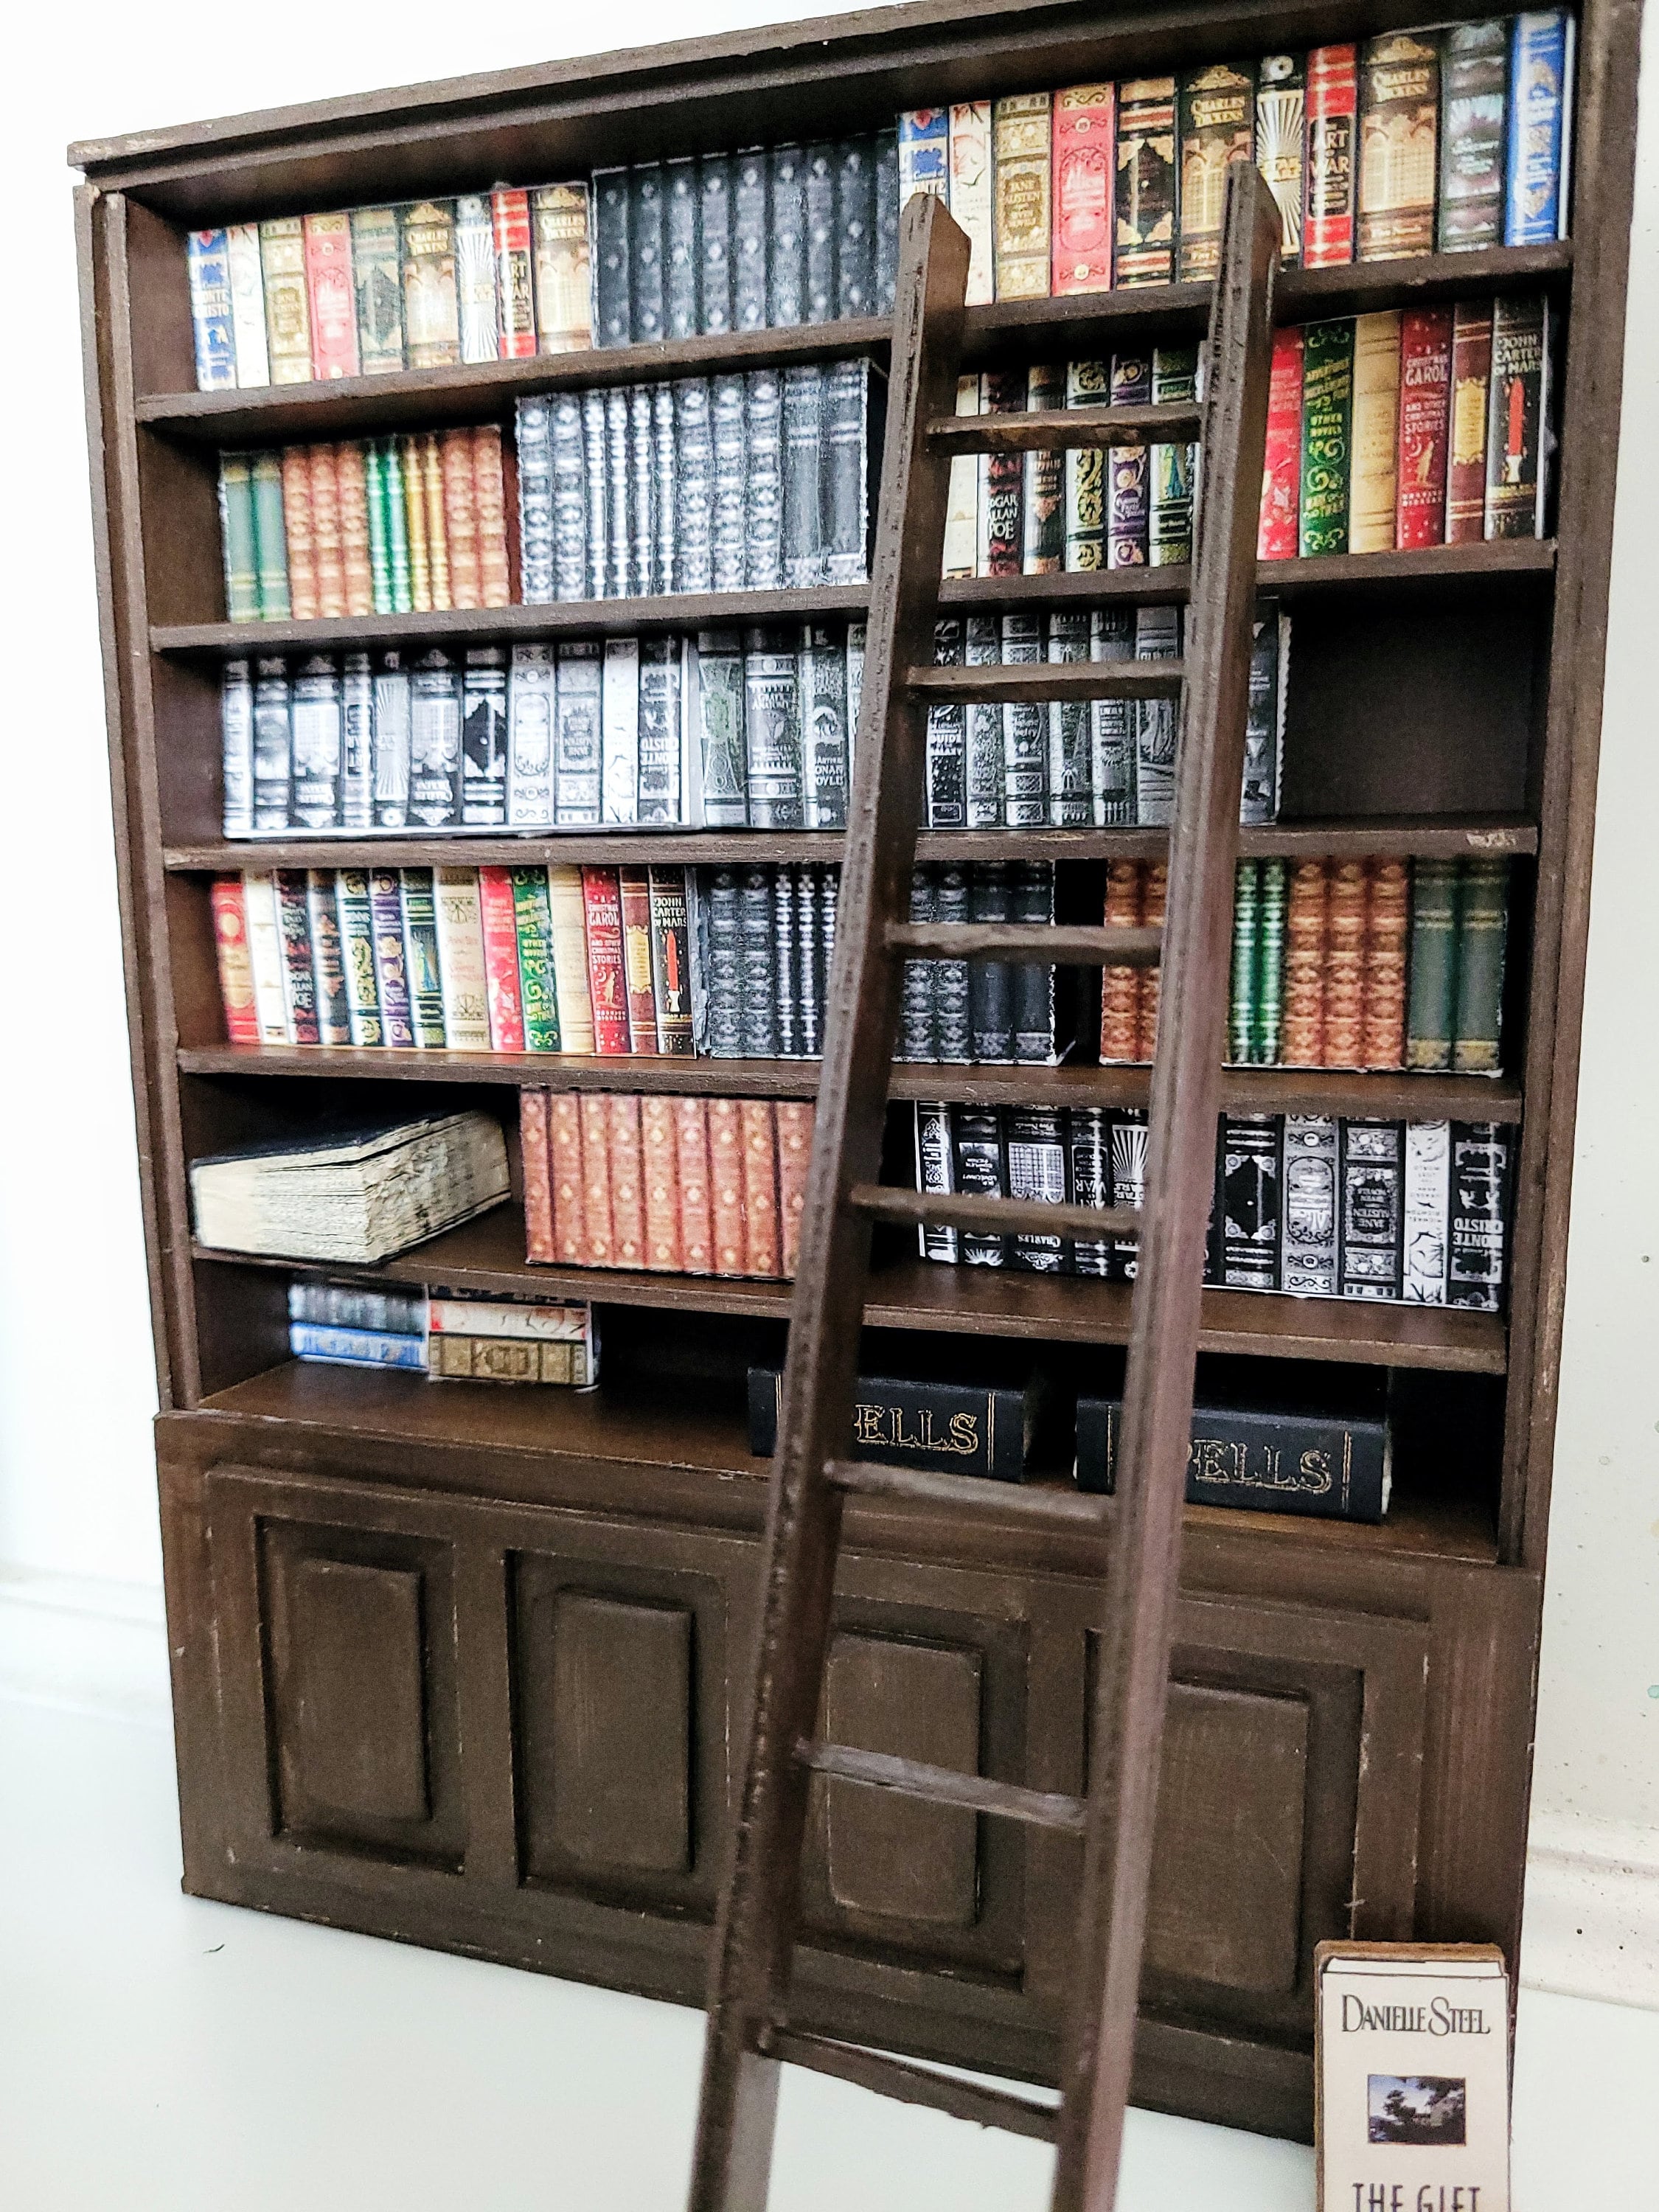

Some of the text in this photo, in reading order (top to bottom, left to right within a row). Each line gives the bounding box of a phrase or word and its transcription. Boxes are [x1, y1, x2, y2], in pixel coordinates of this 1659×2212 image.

[1405, 364, 1448, 386] CAROL
[988, 521, 1015, 540] POE
[653, 897, 682, 907] JOHN
[589, 911, 620, 926] CAROL
[653, 907, 686, 917] CARTER
[664, 917, 687, 927] MARS
[592, 954, 622, 964] STORIES
[1075, 1178, 1107, 1193] WAR
[1353, 1208, 1389, 1218] AUSTEN
[1357, 1218, 1385, 1228] JANE
[1453, 1217, 1504, 1234] CRISTO
[1016, 1234, 1062, 1248] CHARLES
[1453, 1231, 1503, 1248] ONTE
[854, 1404, 979, 1455] ELLS
[1186, 1438, 1332, 1495] ELLS
[1341, 1994, 1491, 2037] DANIELLE STEEL
[1352, 2183, 1481, 2212] THE GIFT
